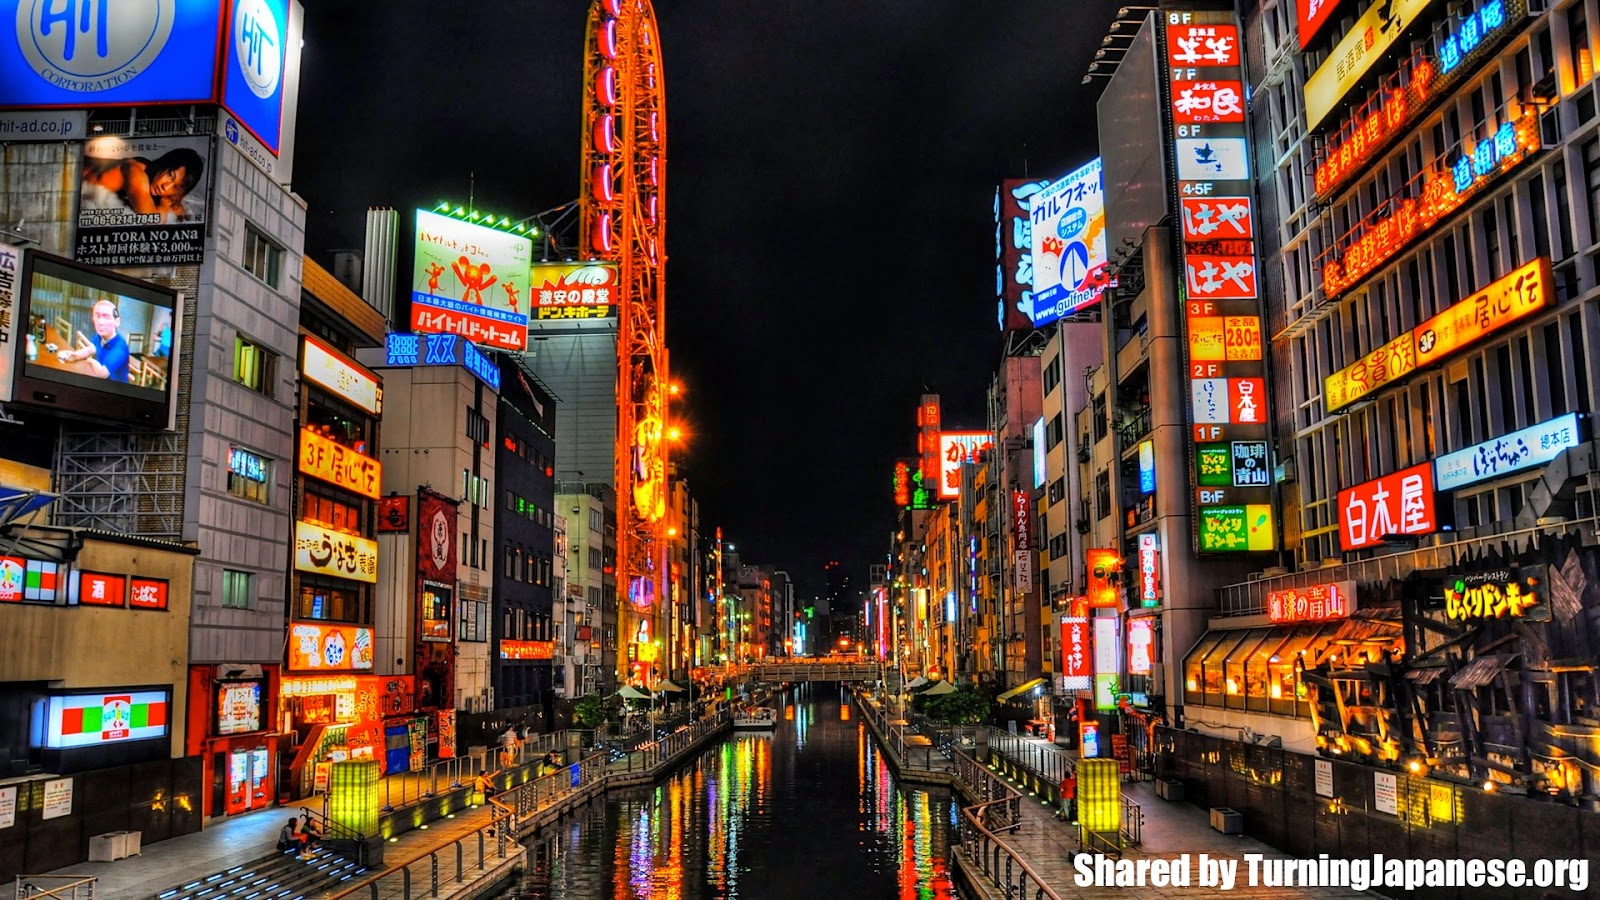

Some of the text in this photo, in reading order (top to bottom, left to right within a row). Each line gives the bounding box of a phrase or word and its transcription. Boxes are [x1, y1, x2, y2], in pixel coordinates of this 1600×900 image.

[41, 66, 138, 92] CORPORATION
[1175, 88, 1242, 115] 和民
[93, 214, 160, 225] 06-6214-7845
[1185, 204, 1249, 236] はや
[112, 231, 146, 242] TORA
[150, 231, 169, 241] NO
[1188, 261, 1253, 294] はや
[539, 289, 610, 305] 激安の殿堂
[1474, 270, 1538, 329] 居心伝
[417, 311, 521, 347] バイトルドットコム
[1229, 318, 1256, 327] 全品
[1227, 328, 1260, 347] 280円
[1420, 330, 1434, 353] 3F
[1350, 336, 1413, 398] 鳥貴族
[1237, 380, 1258, 422] 白木屋
[307, 442, 325, 469] 3F
[1235, 443, 1265, 459] 珈琲
[1244, 458, 1256, 468] の
[1236, 468, 1266, 484] 青山
[1200, 490, 1225, 503] B1F
[1015, 494, 1028, 549] らーめん専門店
[1345, 473, 1429, 546] 白木屋
[1205, 516, 1243, 533] びっくり
[1204, 532, 1246, 548] ドンキー
[309, 533, 358, 574] うなぎ
[92, 579, 106, 599] 酒
[131, 585, 159, 603] たばこ
[1268, 584, 1345, 621] 珈琲の青山
[1444, 582, 1534, 621] びっくりドンキー
